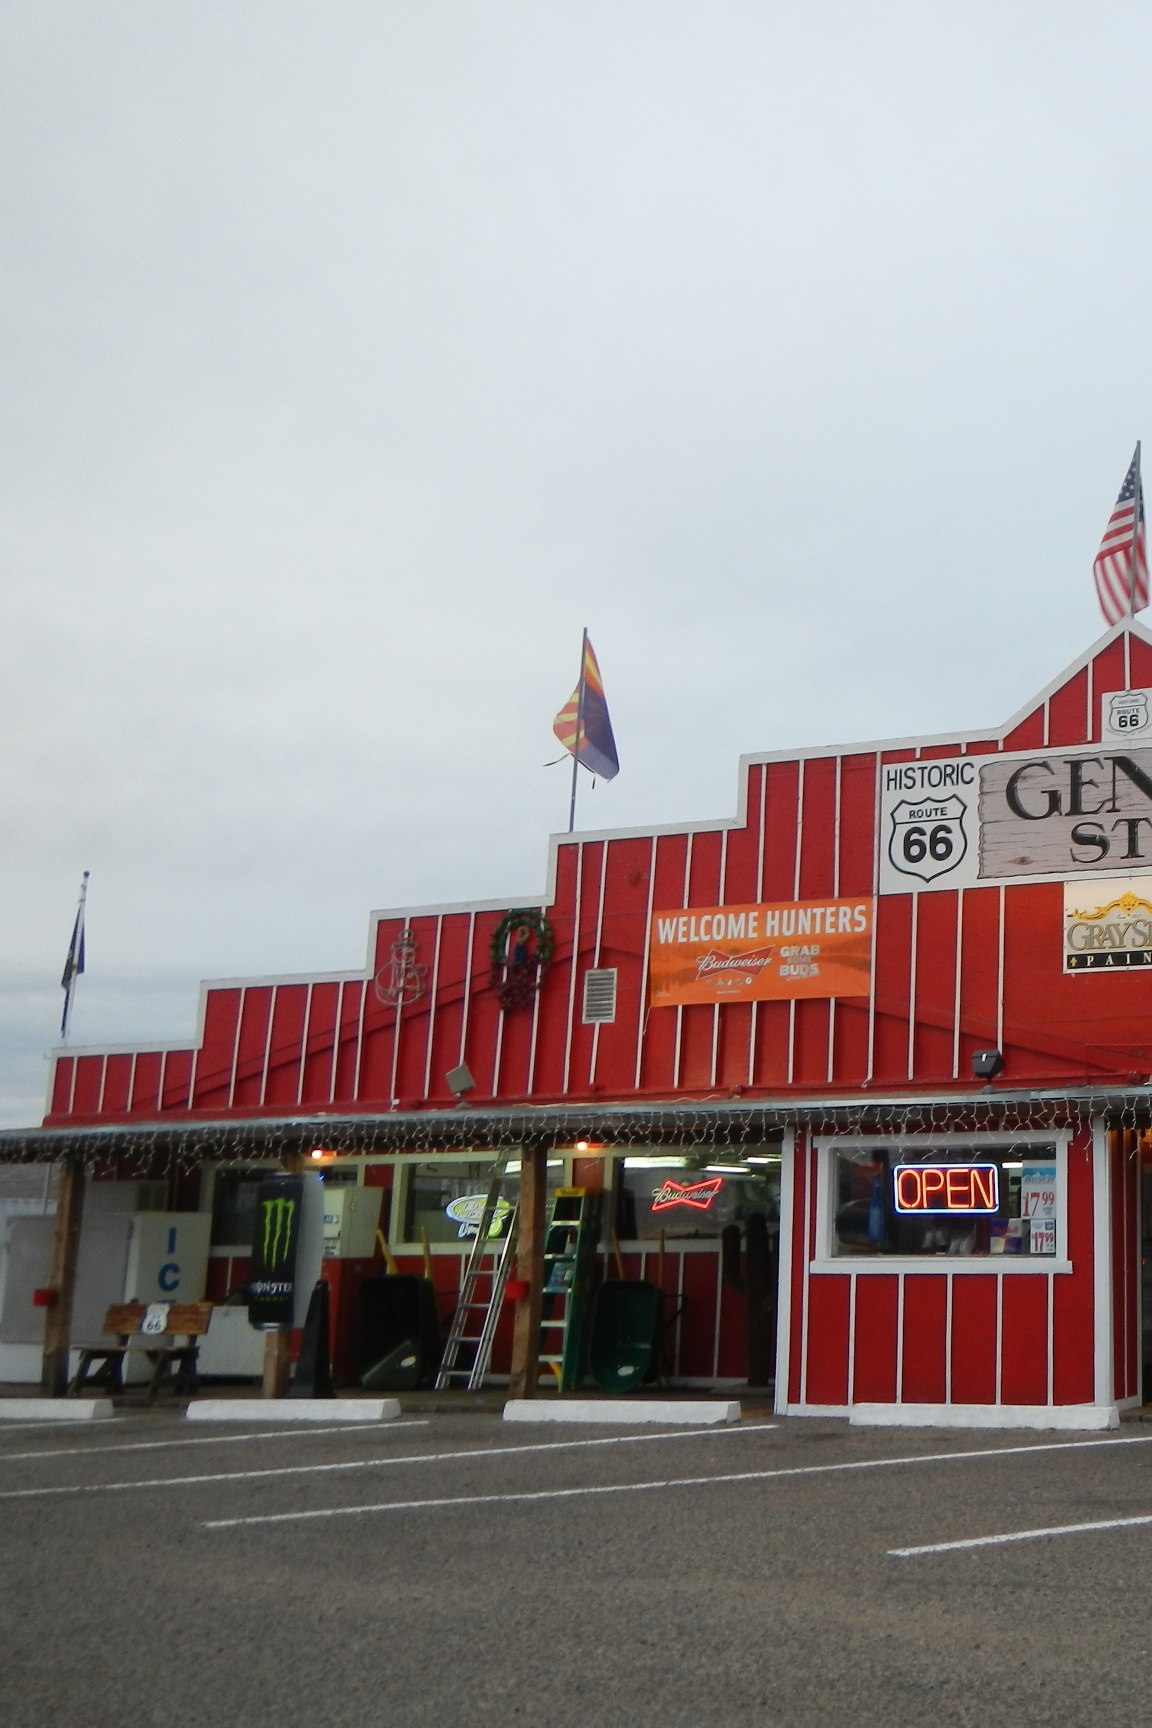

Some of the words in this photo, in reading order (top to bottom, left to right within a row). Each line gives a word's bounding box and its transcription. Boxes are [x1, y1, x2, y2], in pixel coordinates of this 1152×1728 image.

[1118, 714, 1139, 728] 66
[886, 762, 975, 791] HISTORIC
[909, 805, 948, 820] ROUTE
[902, 824, 953, 863] 66
[658, 911, 759, 944] WELCOME
[766, 904, 867, 937] HUNTERS
[1067, 921, 1131, 951] GRAY
[780, 944, 820, 957] GRAB
[696, 954, 772, 972] Budweiser
[779, 963, 820, 978] BUDS
[652, 1187, 719, 1203] Budweiser
[897, 1167, 995, 1210] OPEN
[158, 1226, 181, 1303] IC
[147, 1319, 162, 1331] 66
